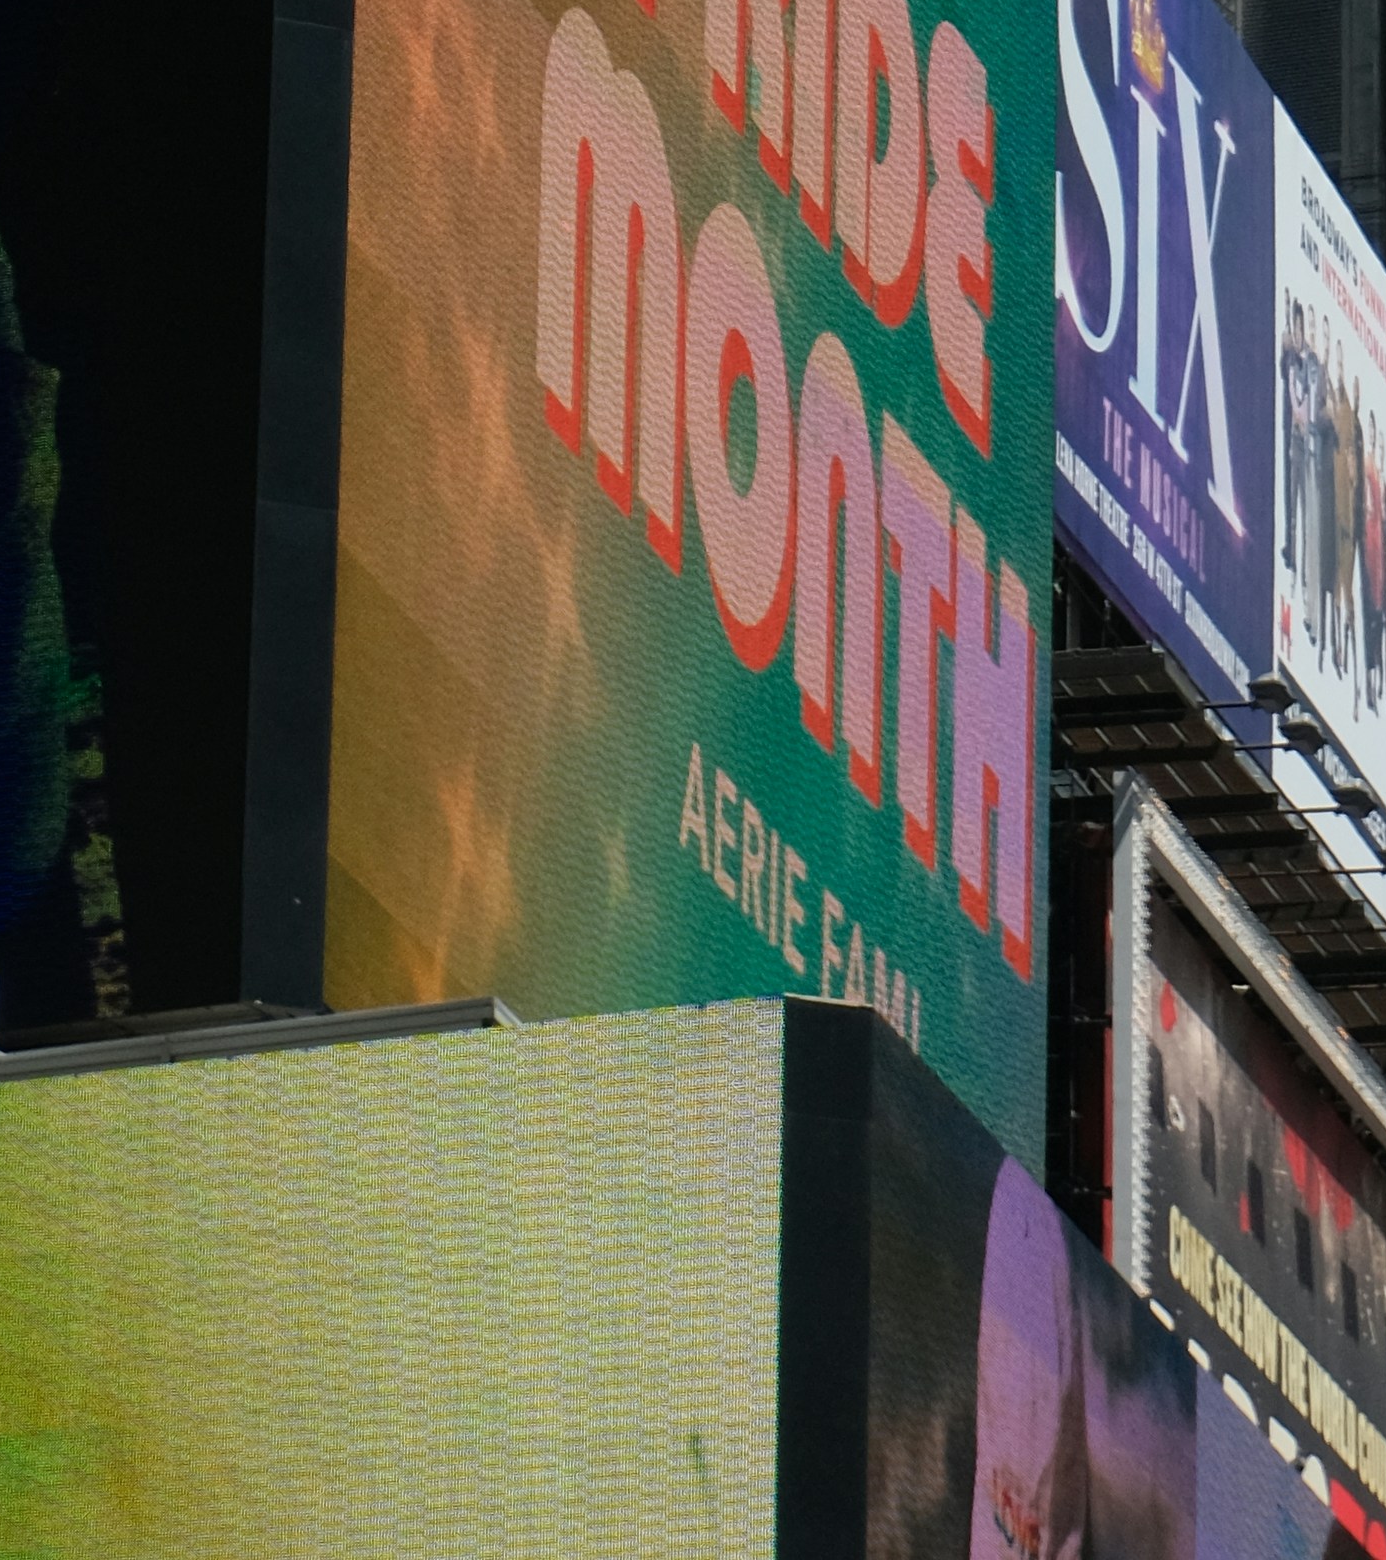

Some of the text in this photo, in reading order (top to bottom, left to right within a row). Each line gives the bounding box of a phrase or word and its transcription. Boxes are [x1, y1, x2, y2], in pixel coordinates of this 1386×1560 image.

[1300, 223, 1319, 272] AND
[1301, 175, 1358, 287] BROADWAY'S
[1103, 396, 1207, 584] THE MUSICAL
[679, 742, 807, 976] AERIE
[1168, 1204, 1217, 1319] COME
[1216, 1253, 1244, 1349] SEE
[1242, 1281, 1279, 1386] HOW
[1278, 1321, 1309, 1419] THE
[1307, 1352, 1359, 1472] WORLD
